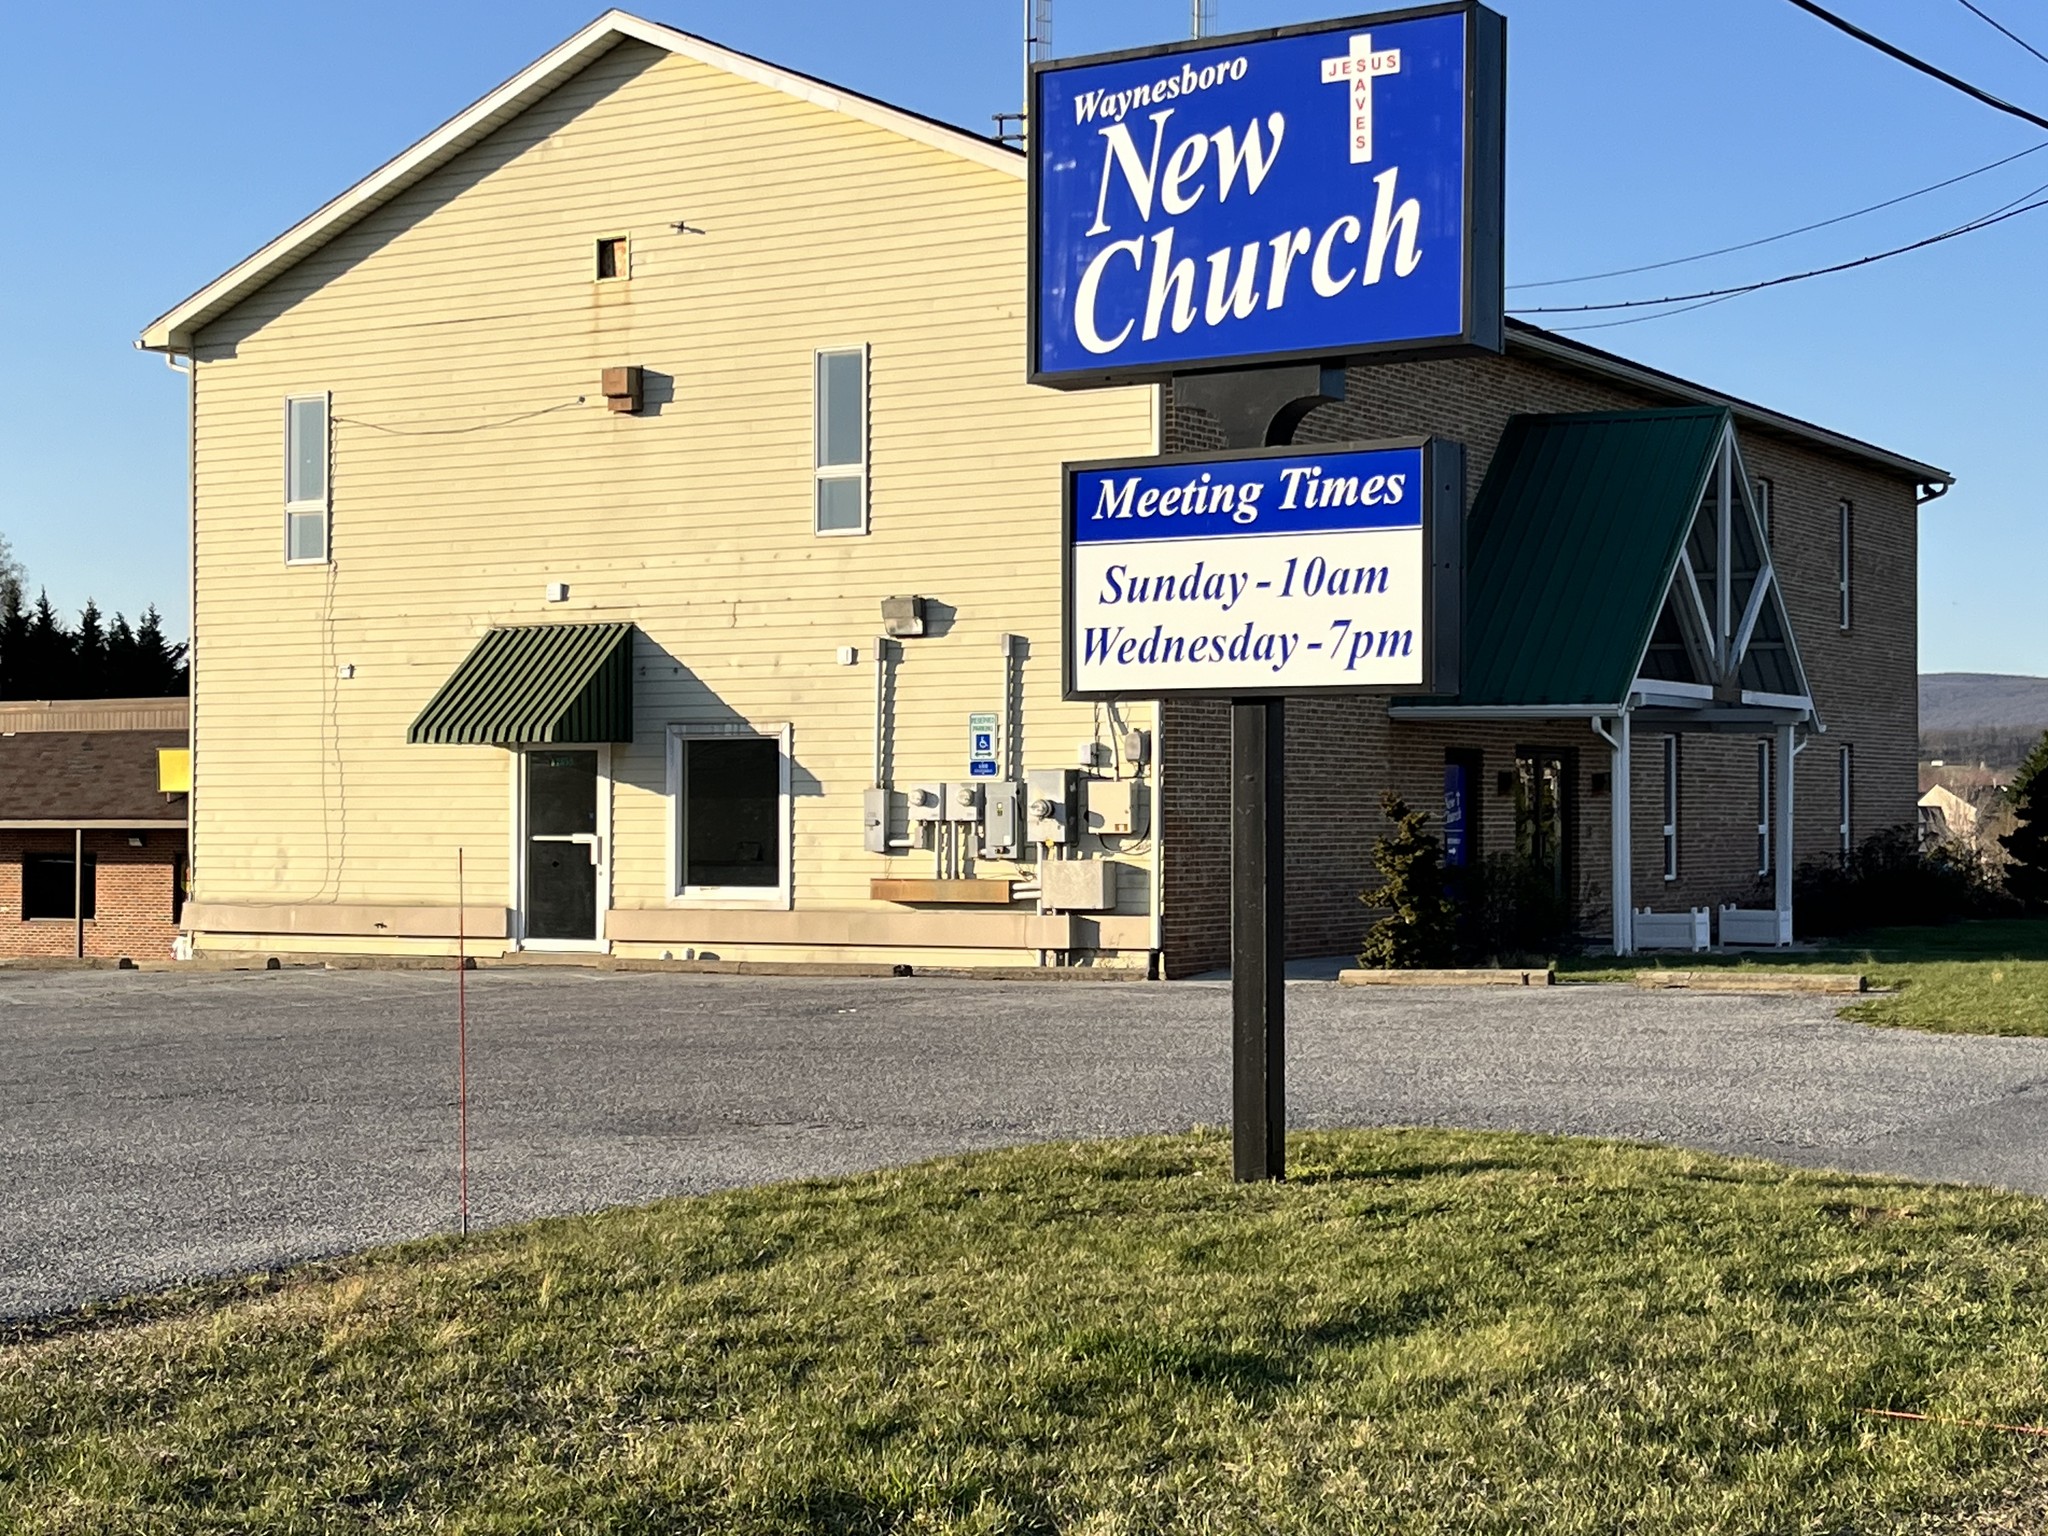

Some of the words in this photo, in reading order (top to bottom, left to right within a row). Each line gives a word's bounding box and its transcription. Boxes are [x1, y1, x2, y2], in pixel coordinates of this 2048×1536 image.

[1074, 56, 1248, 126] Waynesboro
[1328, 54, 1397, 77] JESUS
[1354, 58, 1367, 149] SAVES
[1085, 108, 1285, 237] New
[1074, 166, 1423, 354] Church
[1091, 472, 1264, 524] Meeting
[1278, 465, 1406, 509] Times
